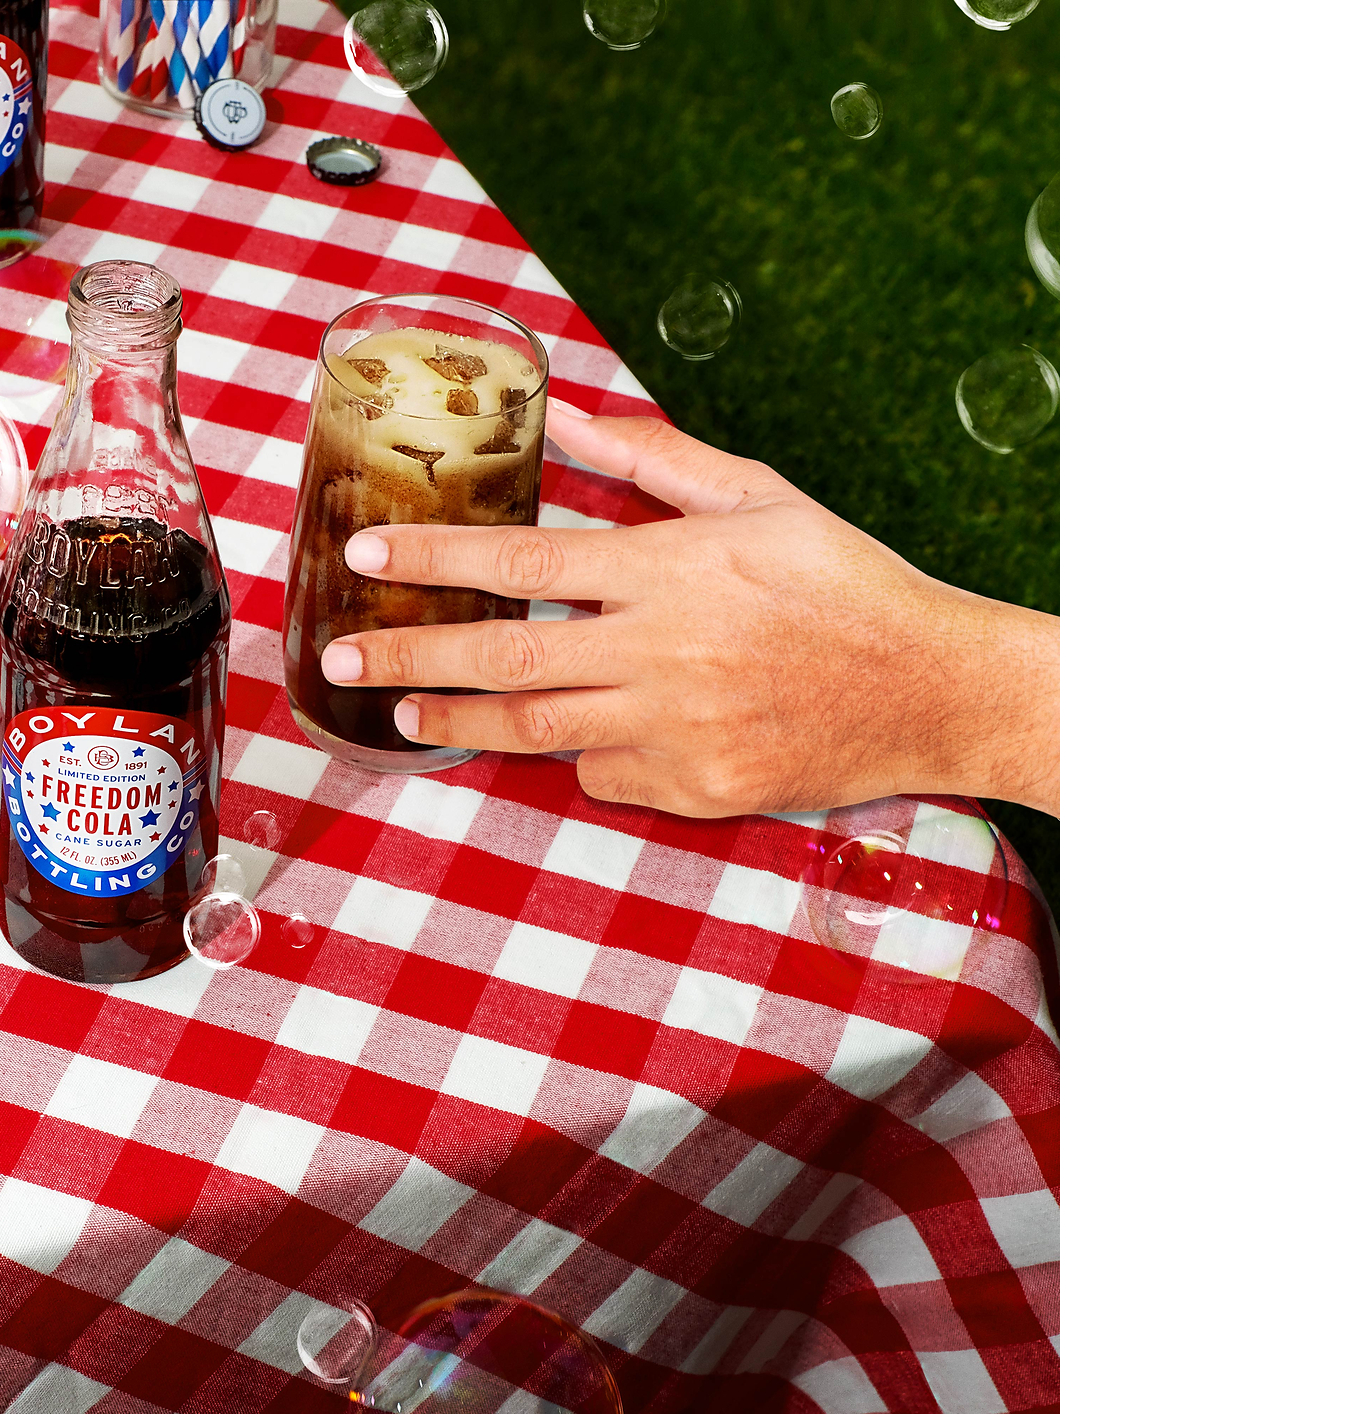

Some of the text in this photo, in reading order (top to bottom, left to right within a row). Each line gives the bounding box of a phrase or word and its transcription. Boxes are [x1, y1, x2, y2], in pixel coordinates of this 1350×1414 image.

[1, 122, 25, 158] CO
[26, 517, 180, 590] BOYLAN
[8, 712, 201, 766] BOYLAN
[58, 767, 147, 783] LIMITED EDITION
[59, 755, 82, 768] EST.
[124, 760, 148, 771] 1891
[41, 774, 162, 810] FREEDOM
[66, 808, 133, 837] COLA
[7, 795, 195, 891] BOTTLING CO
[55, 832, 143, 848] CANE SUGAR
[59, 846, 138, 868] 12 FL. OZ. (355 ML)
